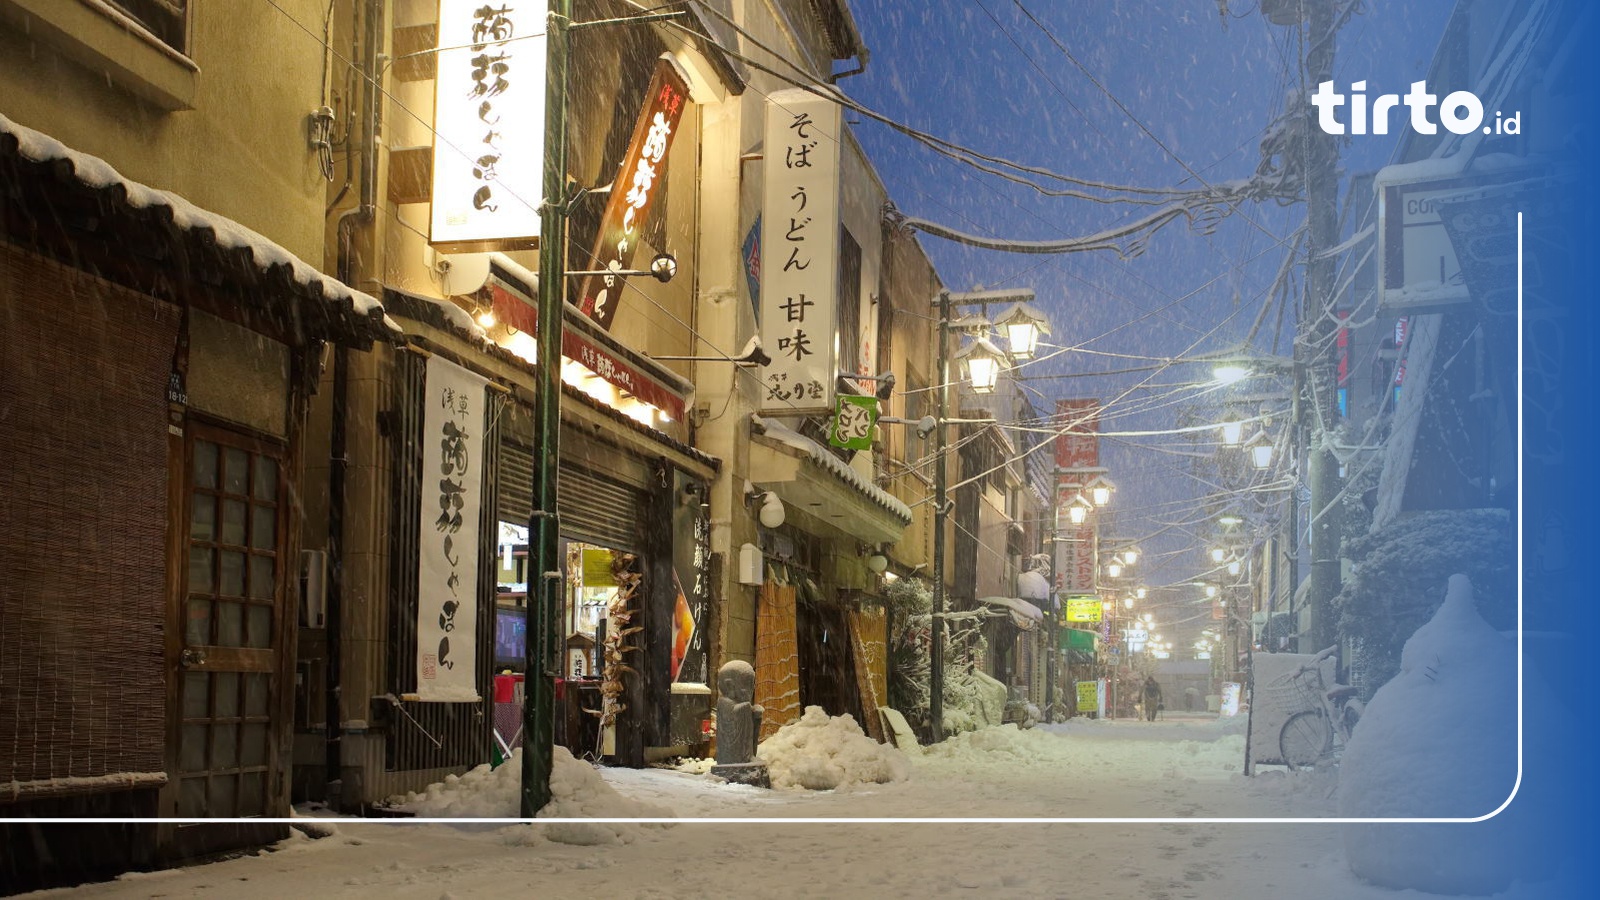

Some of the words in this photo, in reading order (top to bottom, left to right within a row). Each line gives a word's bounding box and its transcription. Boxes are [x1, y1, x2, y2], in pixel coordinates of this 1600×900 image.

[786, 113, 818, 169] そば
[784, 186, 813, 272] うどん
[778, 294, 815, 362] 甘味
[441, 387, 470, 420] 浅草
[692, 517, 704, 651] 洗顔石けん
